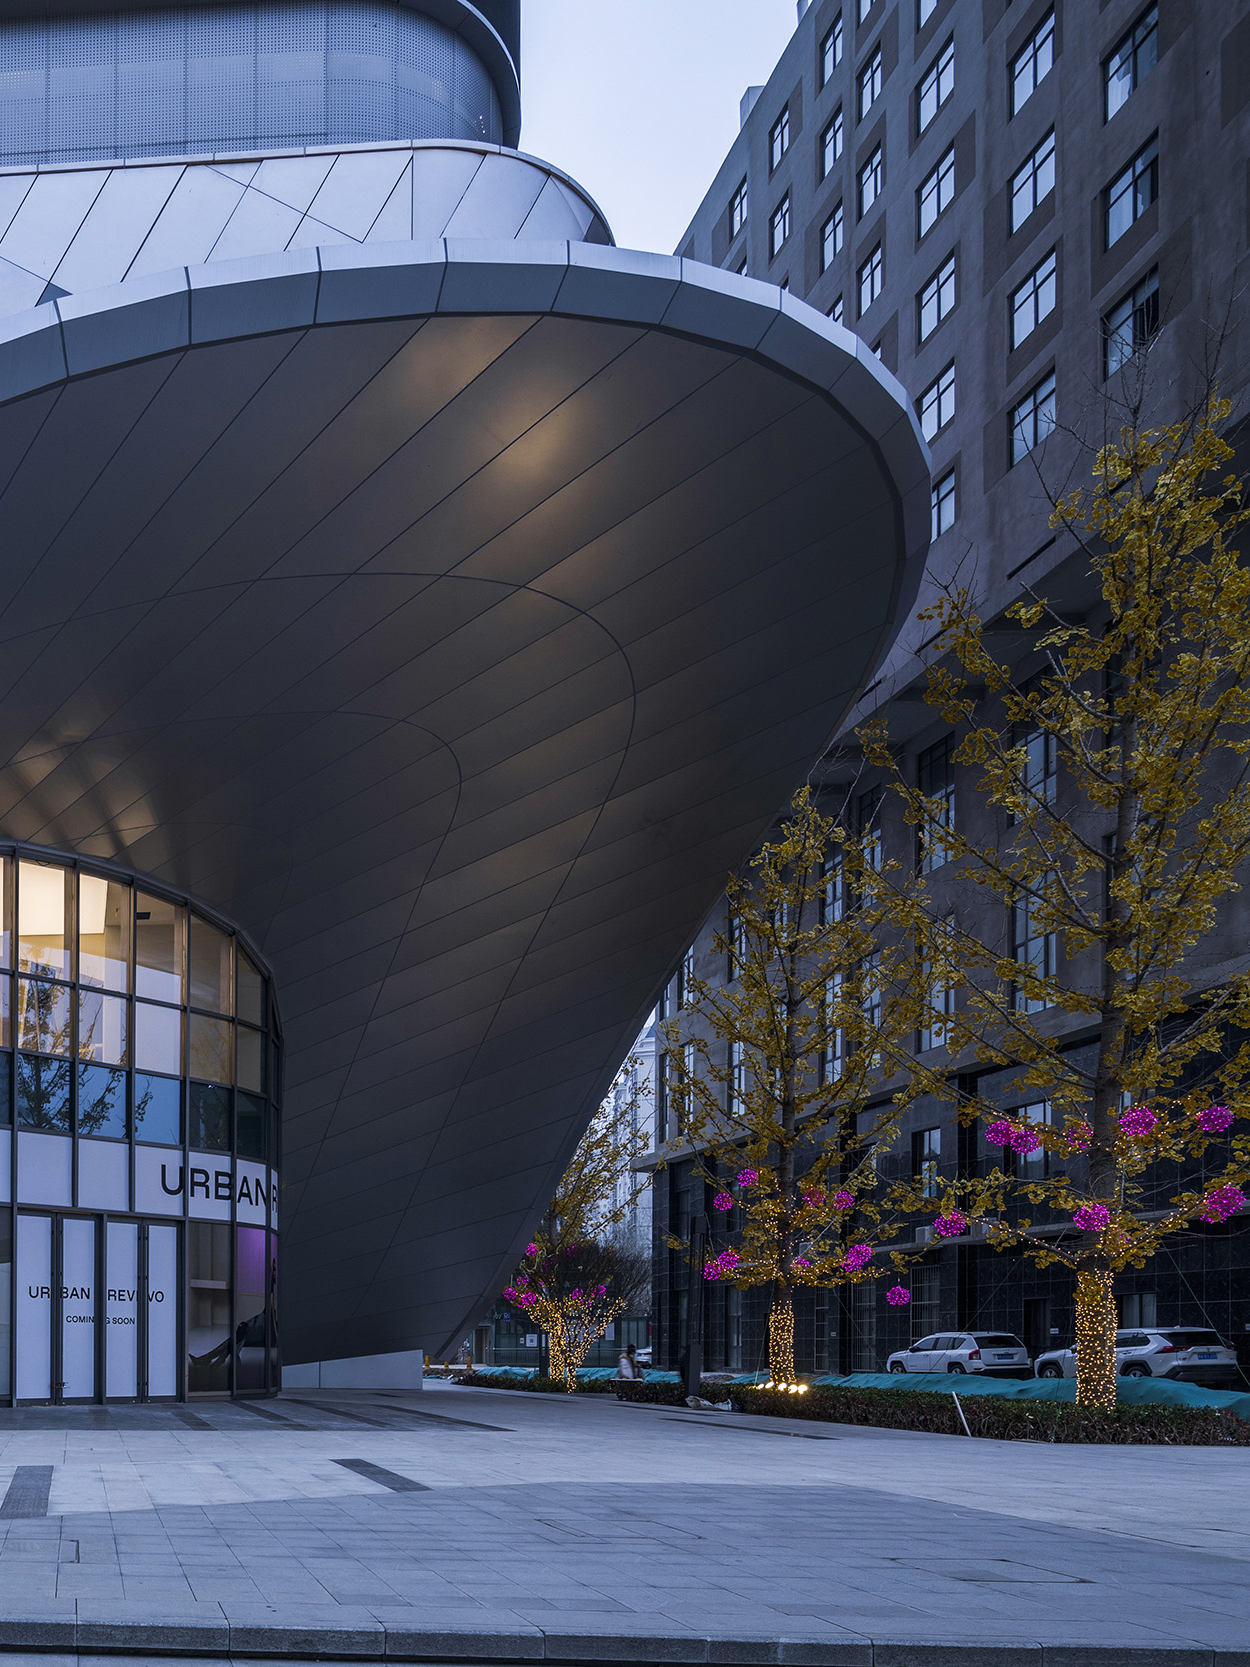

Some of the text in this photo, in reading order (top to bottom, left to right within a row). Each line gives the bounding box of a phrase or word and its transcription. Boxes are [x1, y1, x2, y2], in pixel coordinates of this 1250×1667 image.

[161, 1164, 267, 1208] URBAN
[28, 1285, 165, 1303] URBAN REVIVO
[65, 1315, 136, 1325] COMING SOON
